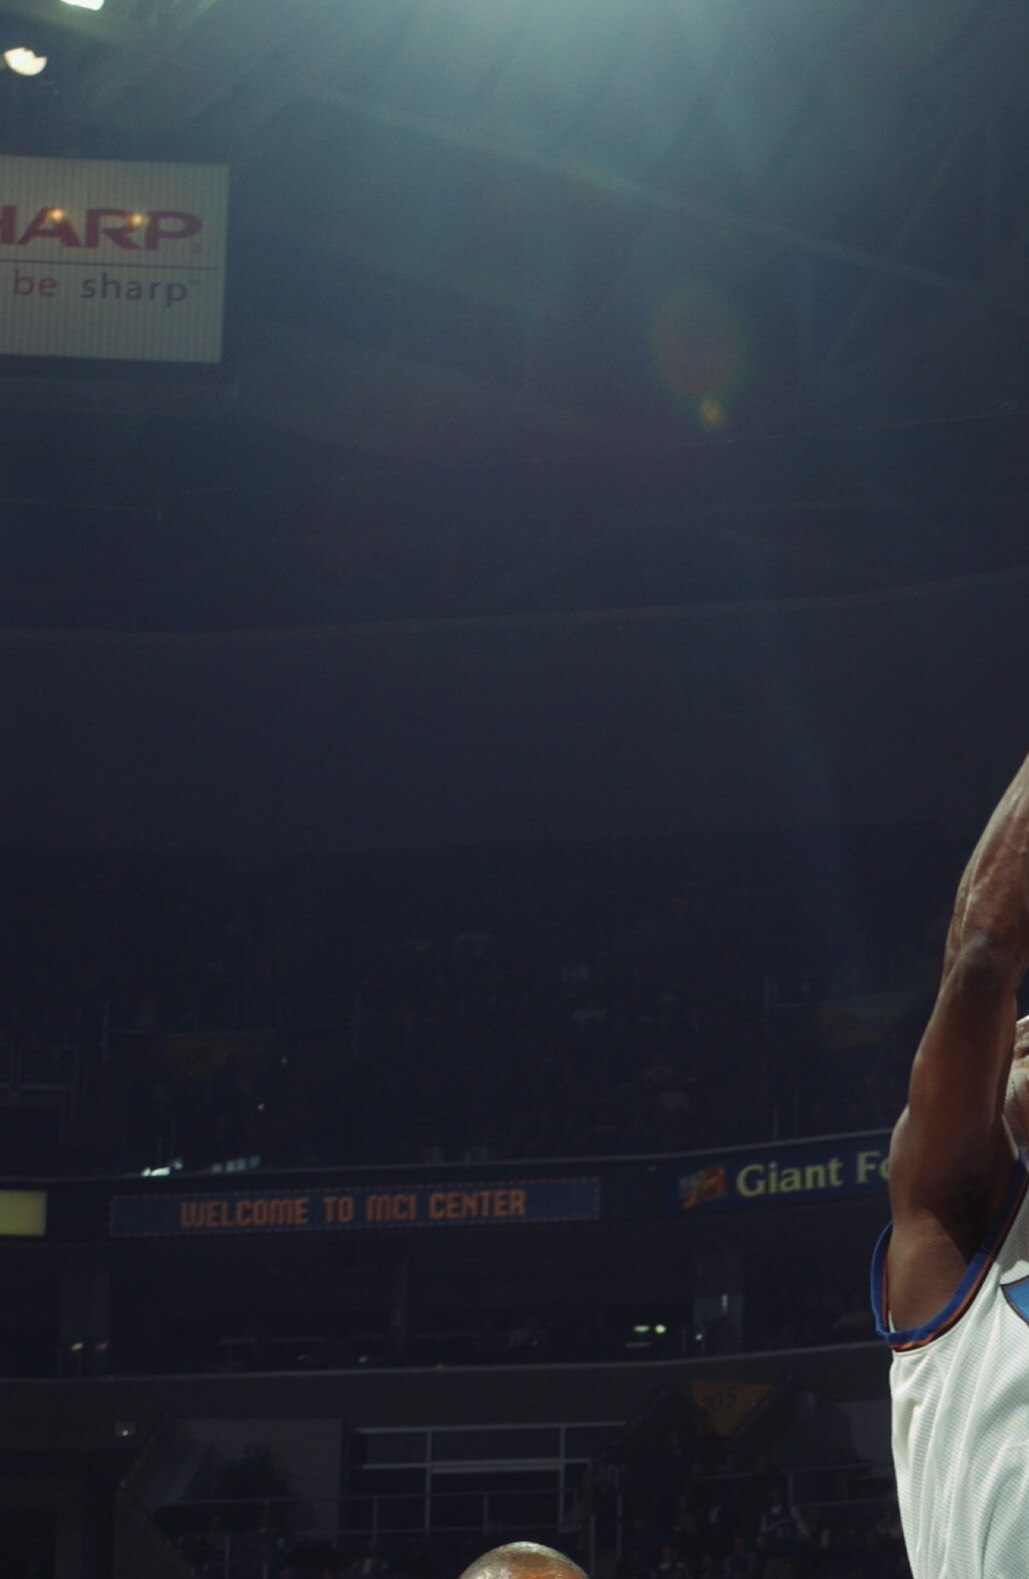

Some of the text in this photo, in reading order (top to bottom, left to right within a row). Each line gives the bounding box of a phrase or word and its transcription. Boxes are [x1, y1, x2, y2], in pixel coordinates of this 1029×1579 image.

[14, 269, 188, 307] be sharp
[736, 1156, 843, 1198] Giant
[179, 1190, 525, 1228] WELCOME TO MCI CENTER
